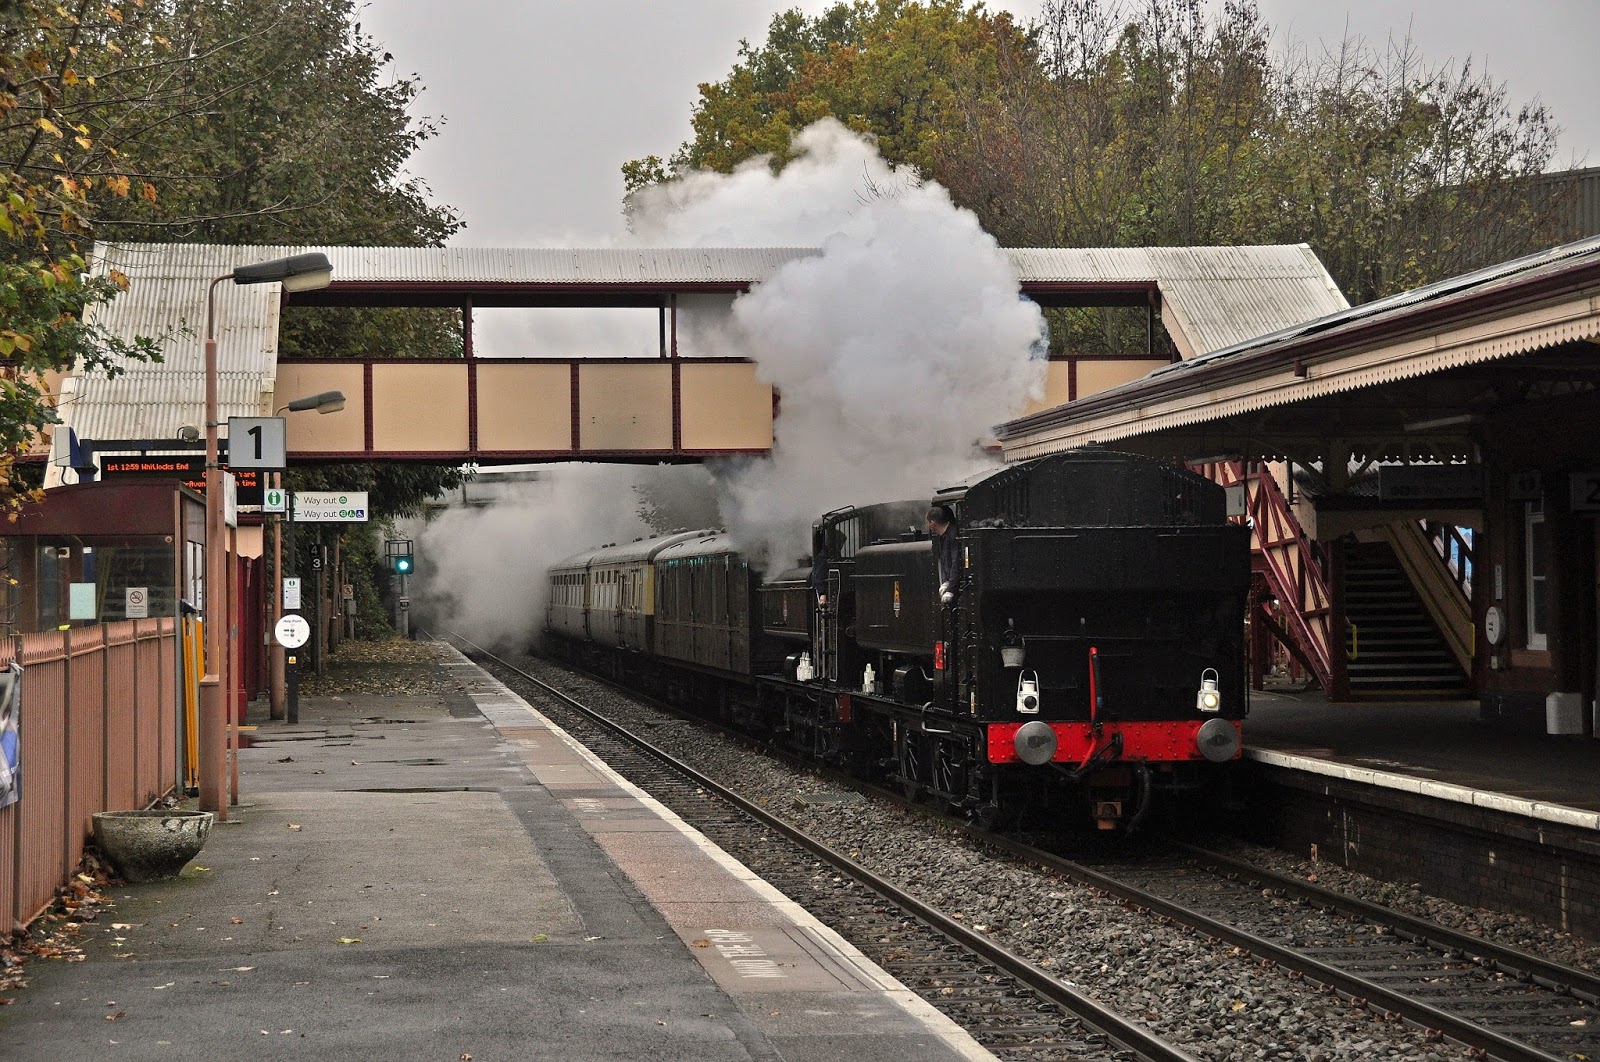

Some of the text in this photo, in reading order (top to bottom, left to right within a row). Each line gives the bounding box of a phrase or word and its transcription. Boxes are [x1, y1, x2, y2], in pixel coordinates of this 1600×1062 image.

[247, 426, 261, 459] 1
[1586, 478, 1600, 503] 2
[303, 496, 321, 505] Way
[303, 509, 321, 519] Way
[311, 546, 318, 555] 4
[313, 559, 321, 568] 3
